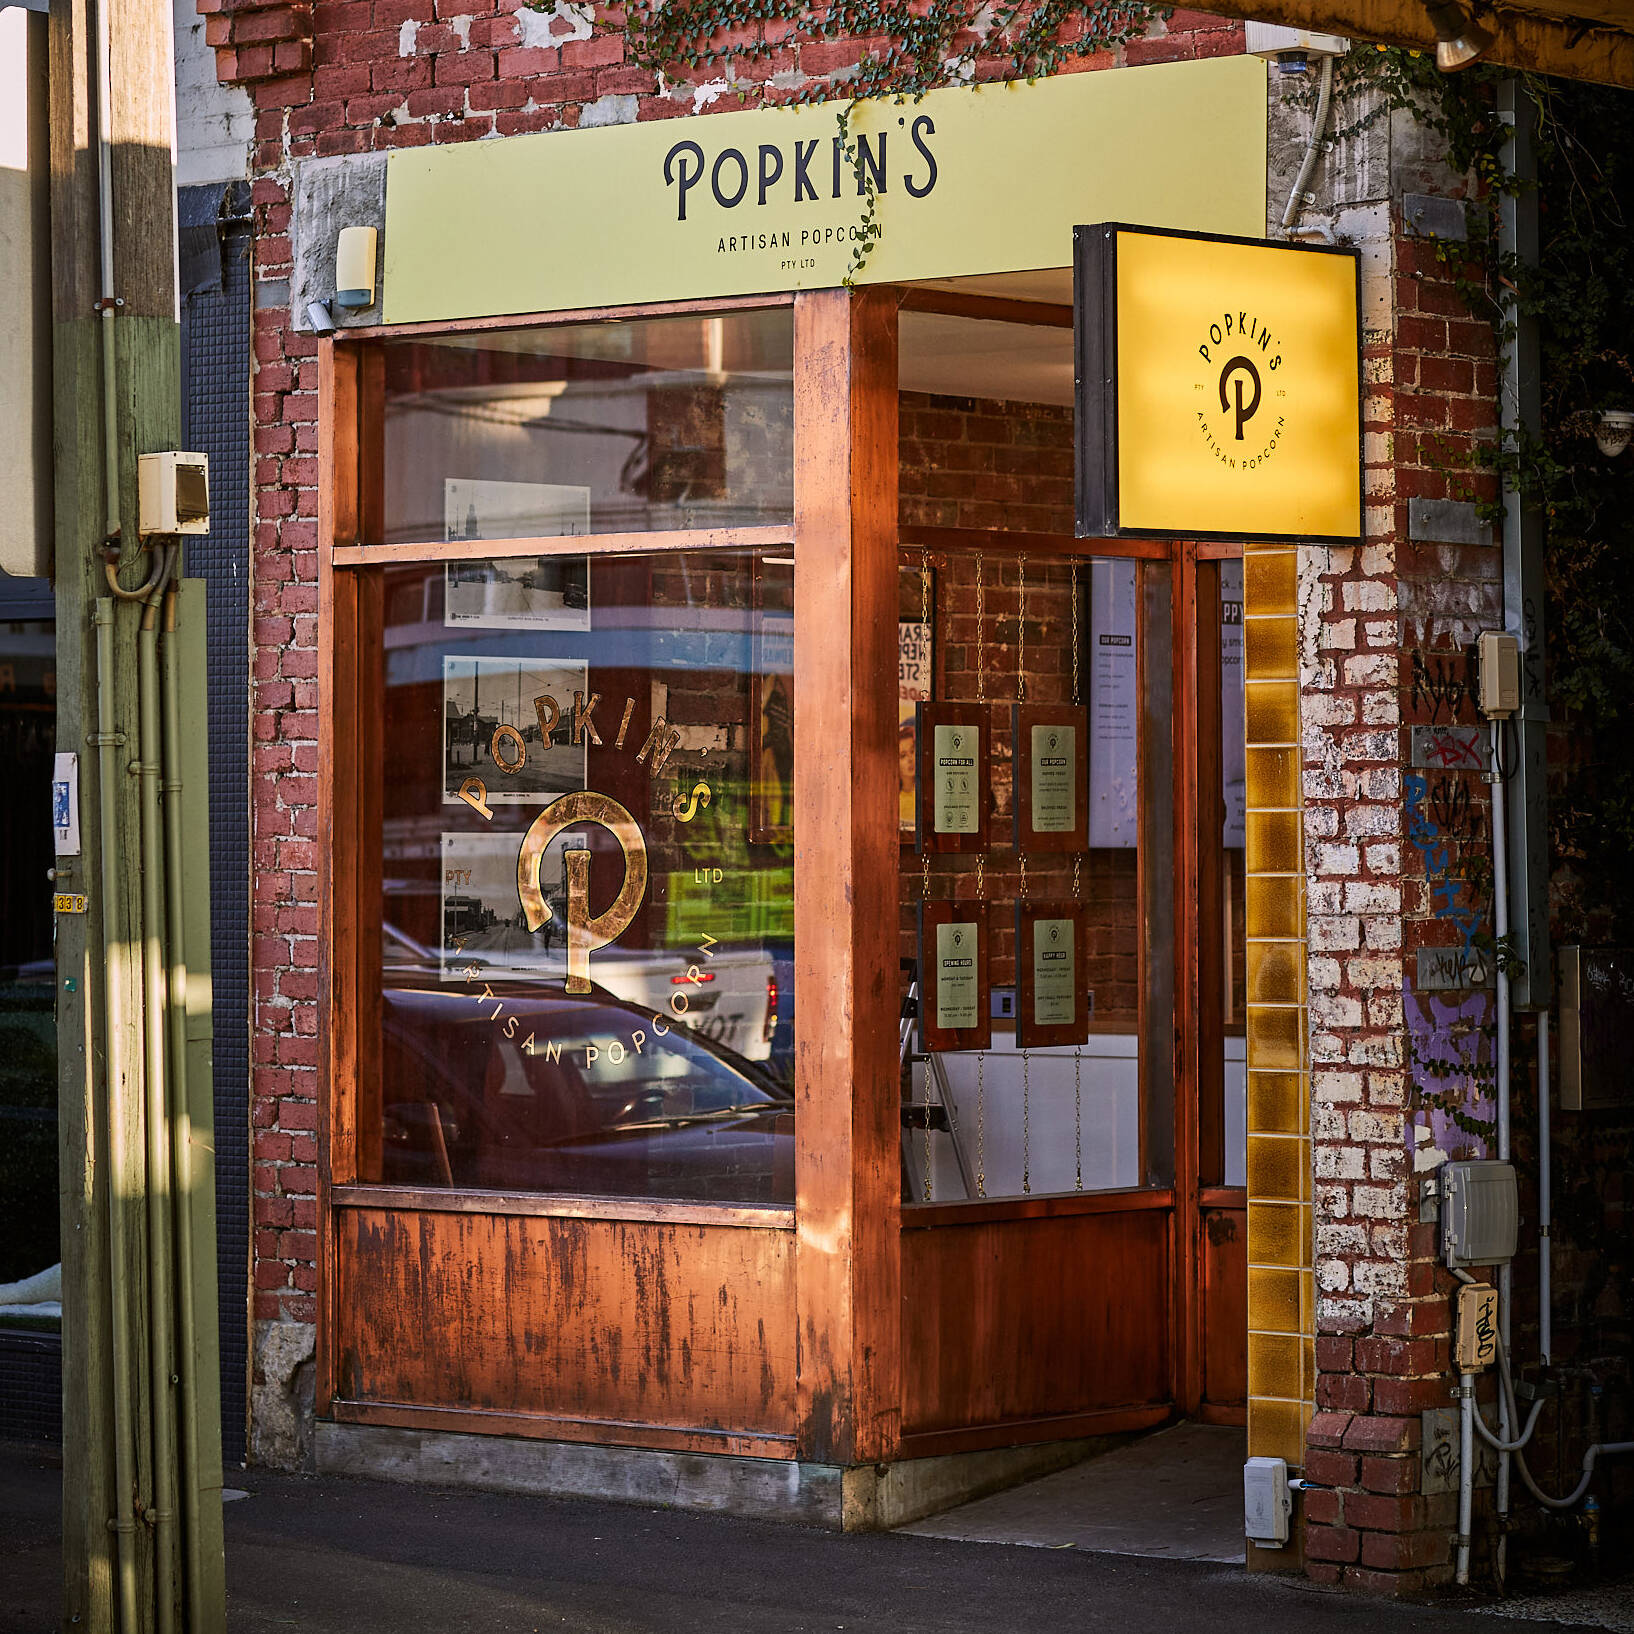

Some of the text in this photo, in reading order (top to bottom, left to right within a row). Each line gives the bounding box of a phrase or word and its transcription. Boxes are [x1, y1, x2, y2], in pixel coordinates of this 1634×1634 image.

[663, 115, 938, 221] POPKIN'S
[717, 232, 791, 253] ARTISAN
[781, 258, 815, 270] PTY LTD
[1198, 311, 1282, 371] POPKIN'S
[1197, 411, 1285, 471] ARTISAN POPCORN
[457, 690, 712, 822] POPKIN'S
[445, 868, 723, 886] PTY LTD
[448, 931, 718, 1070] ARTISAN POPCORN
